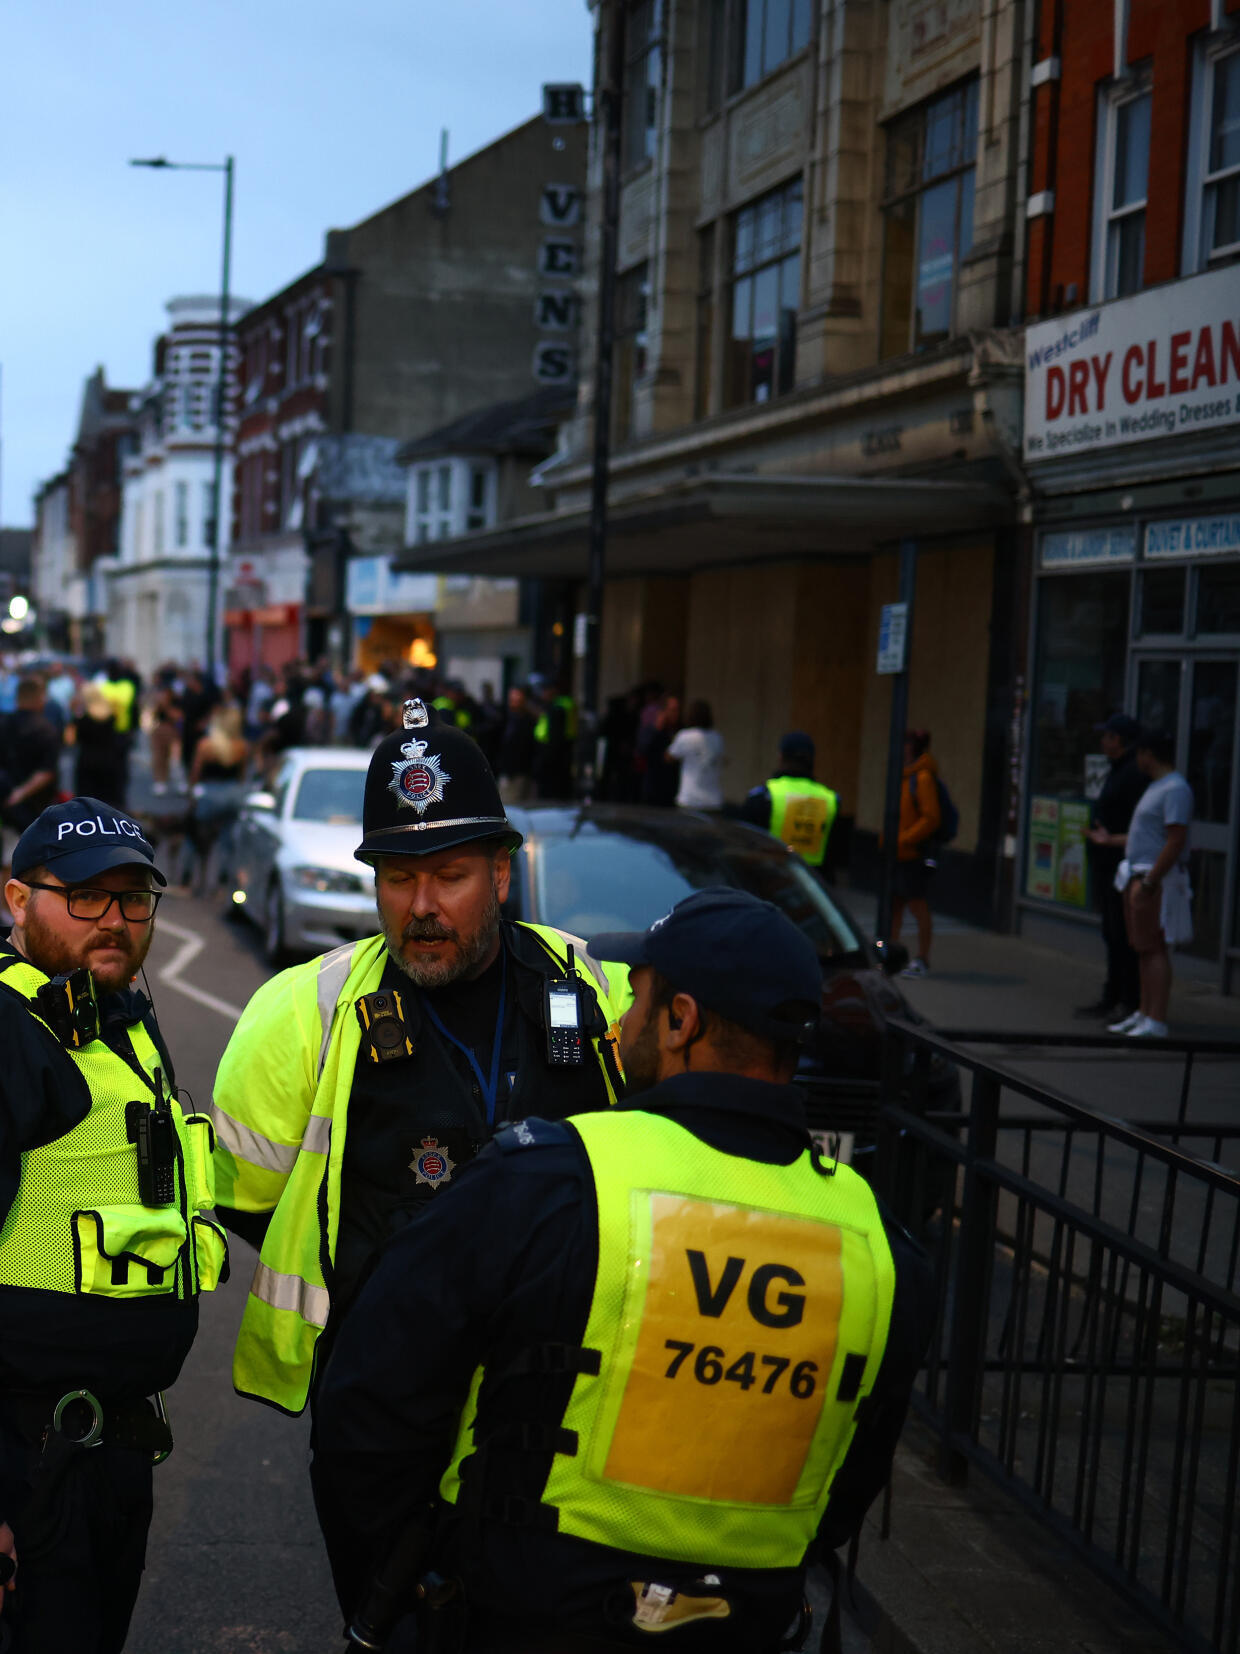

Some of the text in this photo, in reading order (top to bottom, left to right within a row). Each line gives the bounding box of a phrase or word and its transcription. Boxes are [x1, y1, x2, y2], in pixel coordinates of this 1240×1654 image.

[1028, 310, 1101, 371] Westcliff
[1045, 319, 1240, 422] DRY CLEAN
[1027, 435, 1043, 452] We
[1105, 419, 1117, 437] In
[1120, 408, 1176, 432] Wedding
[1180, 396, 1232, 424] Dresses
[406, 788, 432, 799] POLICE
[58, 815, 147, 843] POLICE
[686, 1249, 807, 1329] VG
[664, 1339, 820, 1399] 76476
